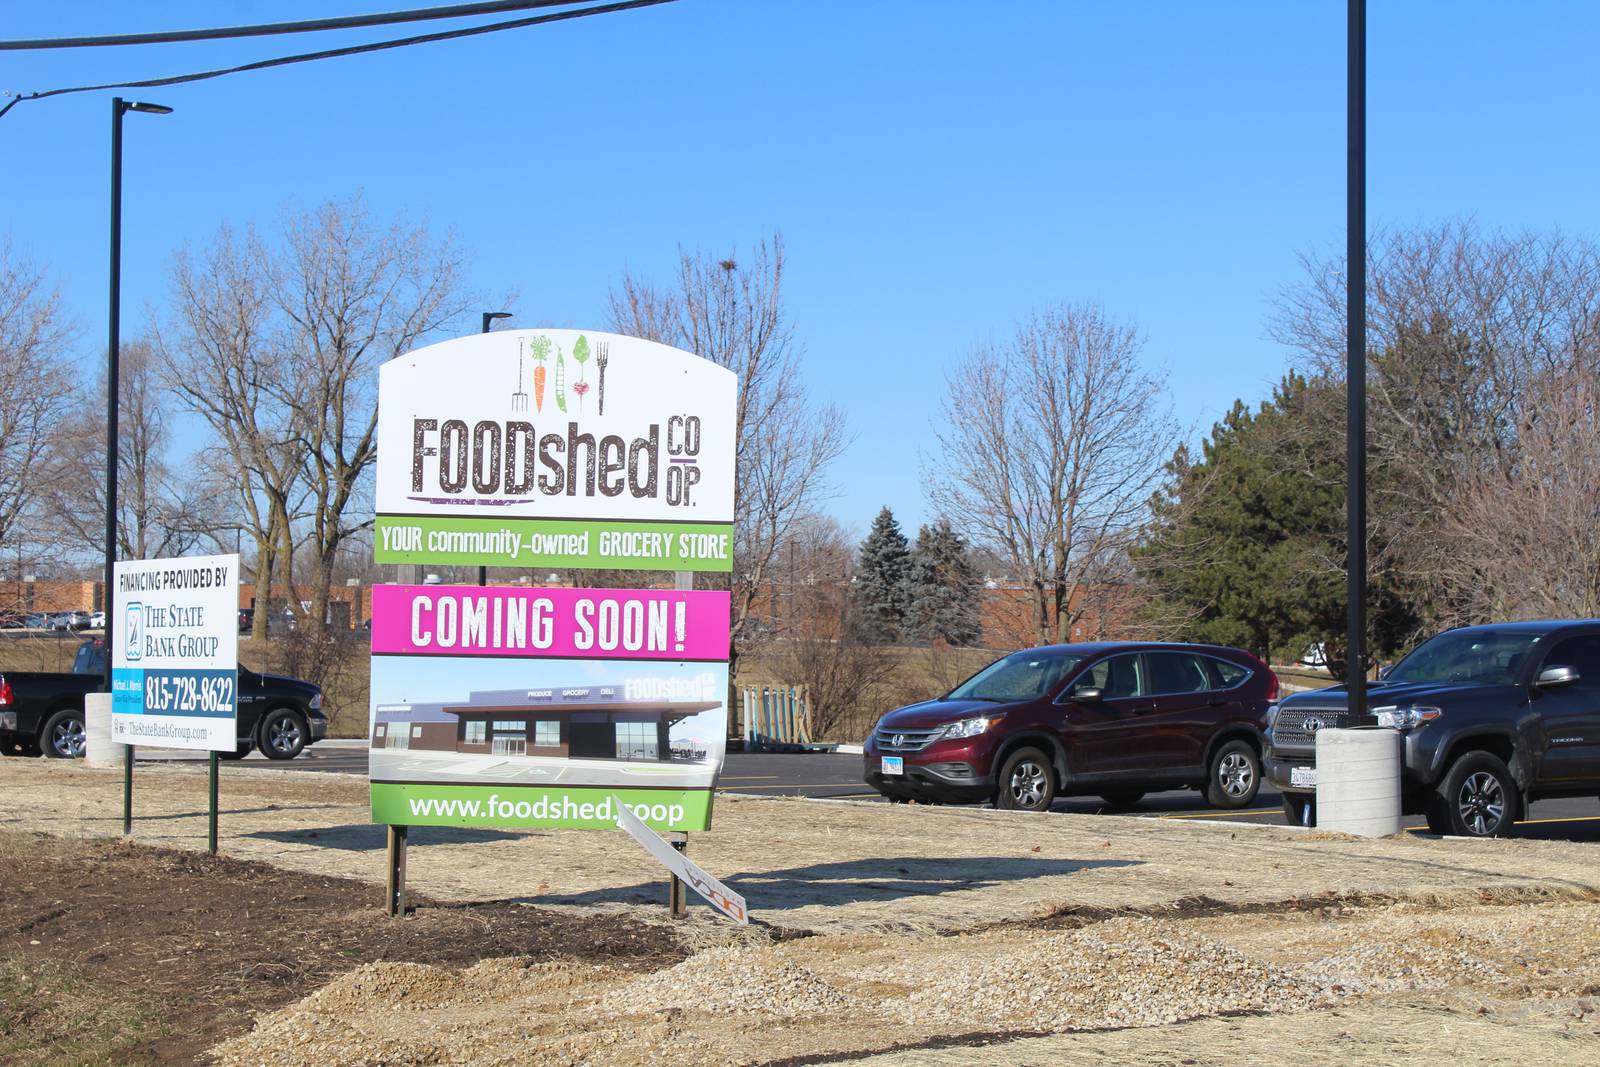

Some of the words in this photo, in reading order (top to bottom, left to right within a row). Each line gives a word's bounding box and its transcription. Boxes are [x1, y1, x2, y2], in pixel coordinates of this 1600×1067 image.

[667, 415, 700, 456] CO
[411, 417, 660, 498] FOODshed
[381, 525, 423, 552] YOUR
[428, 527, 589, 559] community-owned
[599, 531, 674, 558] GROCERY
[679, 533, 728, 559] STORE
[119, 571, 161, 593] FINANCING
[163, 568, 213, 591] PROVIDED
[215, 566, 228, 588] BY
[411, 595, 553, 649] COMING
[574, 599, 687, 652] SOON!
[145, 675, 233, 712] 815-728-8622
[527, 690, 553, 698] PRODUCE
[562, 688, 590, 697] GROCERY
[601, 687, 614, 695] DELI
[129, 721, 208, 743] TheStateBankGroup.com
[409, 793, 685, 827] www.foodshed.oop
